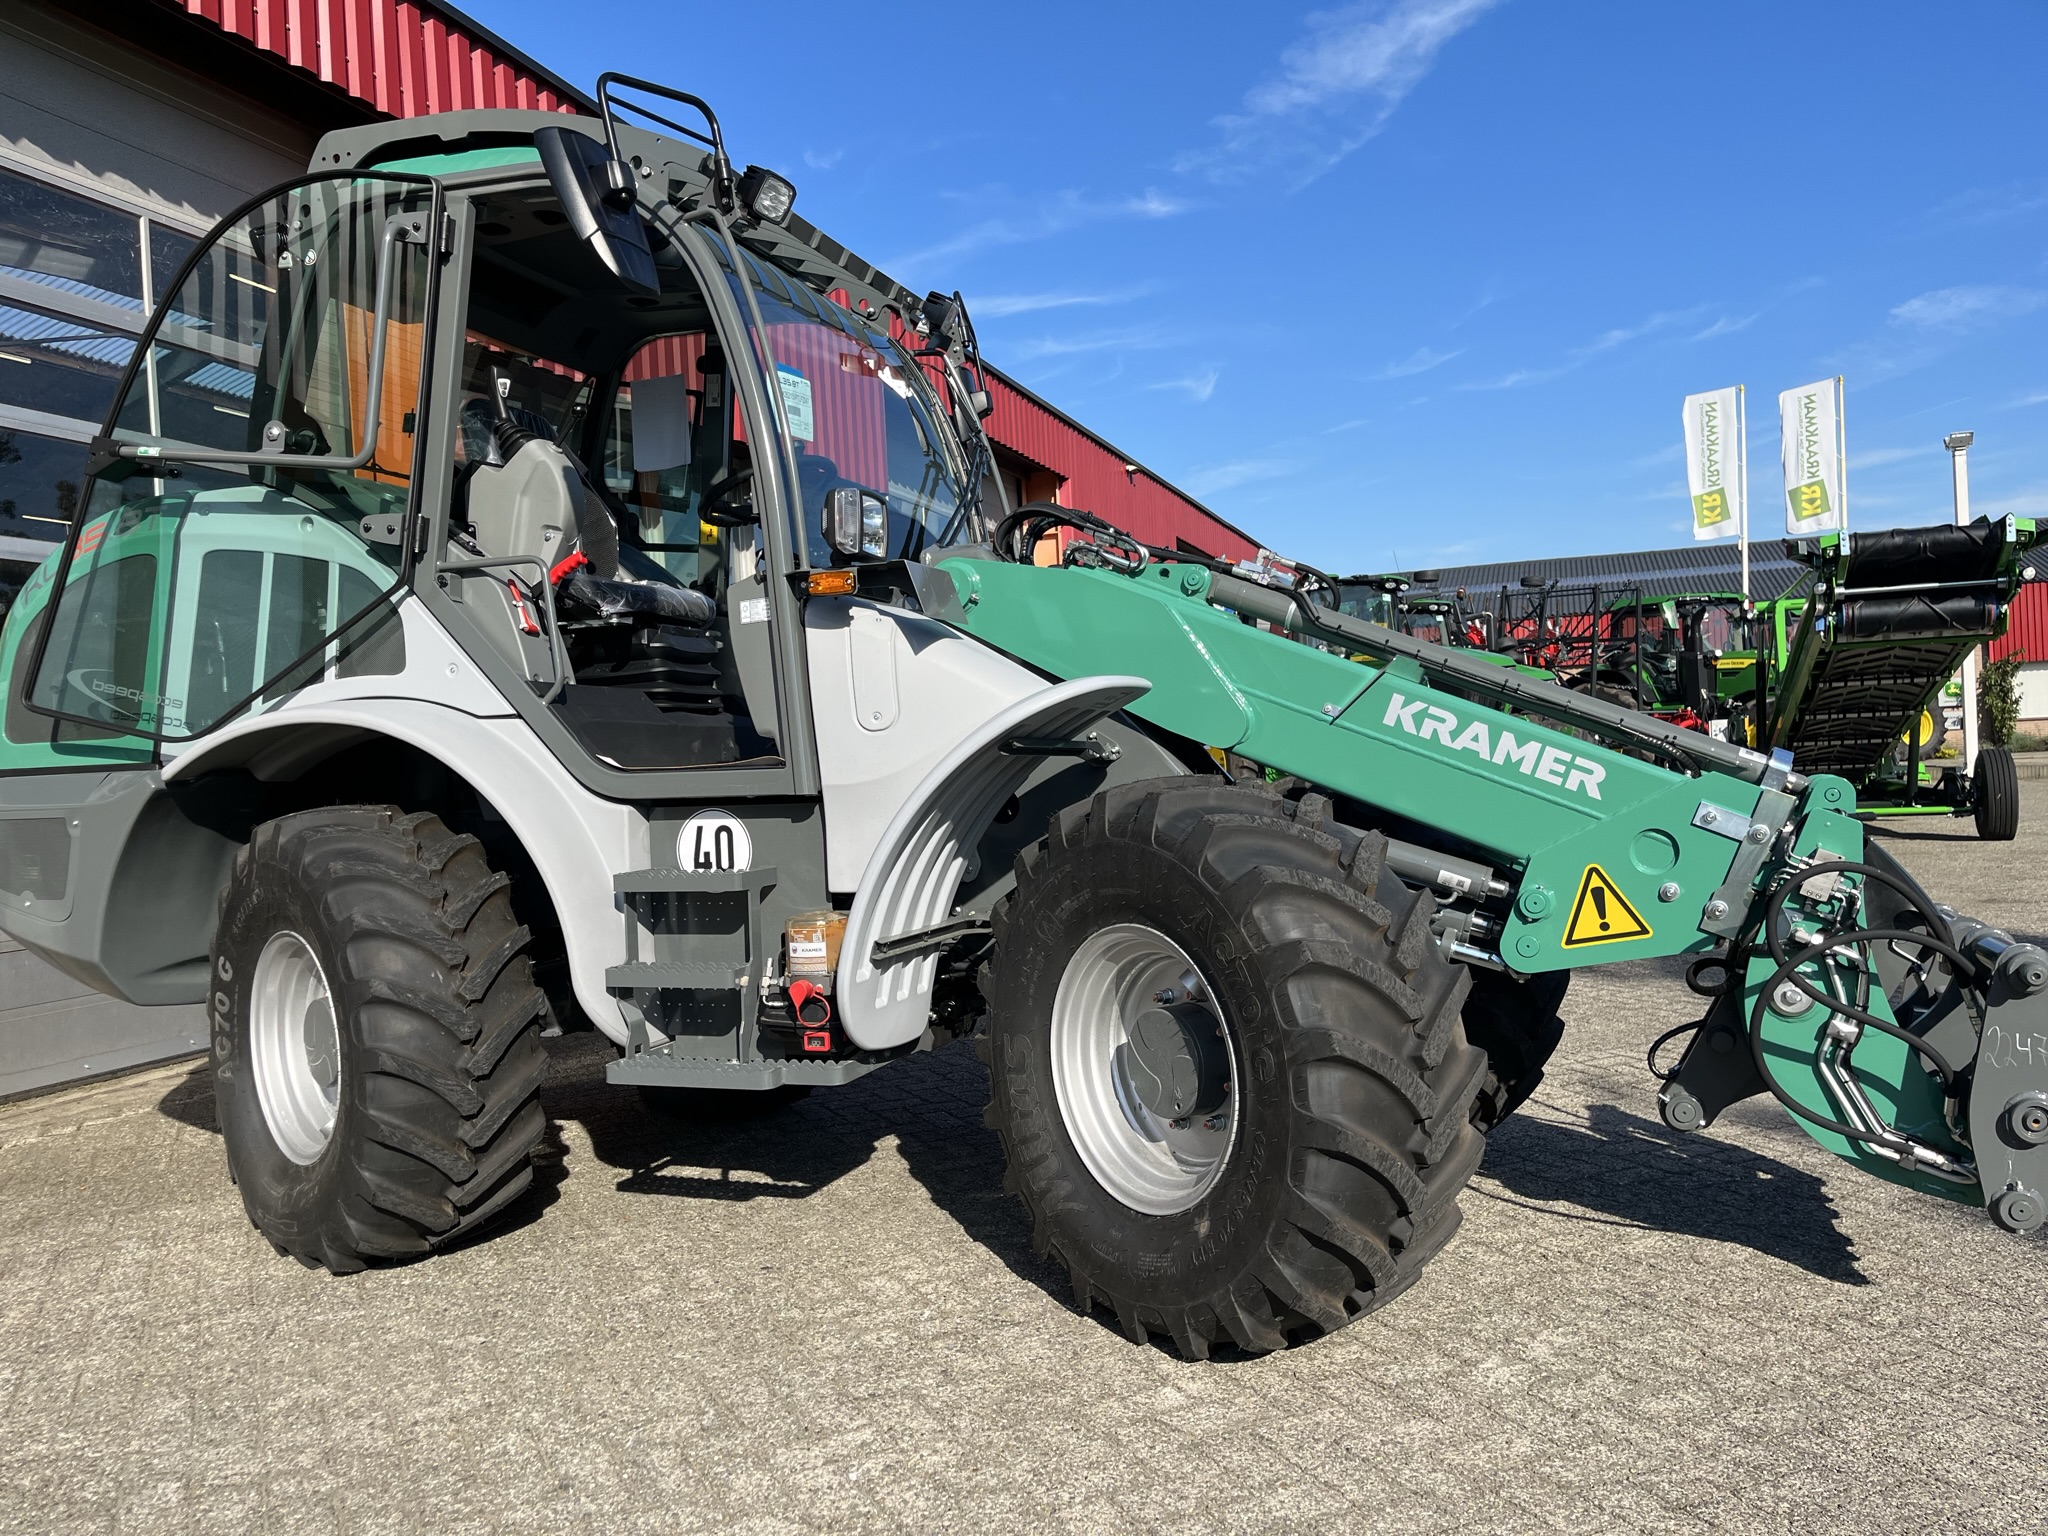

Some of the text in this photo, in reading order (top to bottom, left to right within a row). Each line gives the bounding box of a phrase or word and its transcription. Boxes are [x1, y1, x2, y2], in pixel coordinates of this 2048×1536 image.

[1382, 692, 1607, 801] KRAMER
[693, 824, 735, 873] 40
[214, 955, 234, 1084] AC70 G
